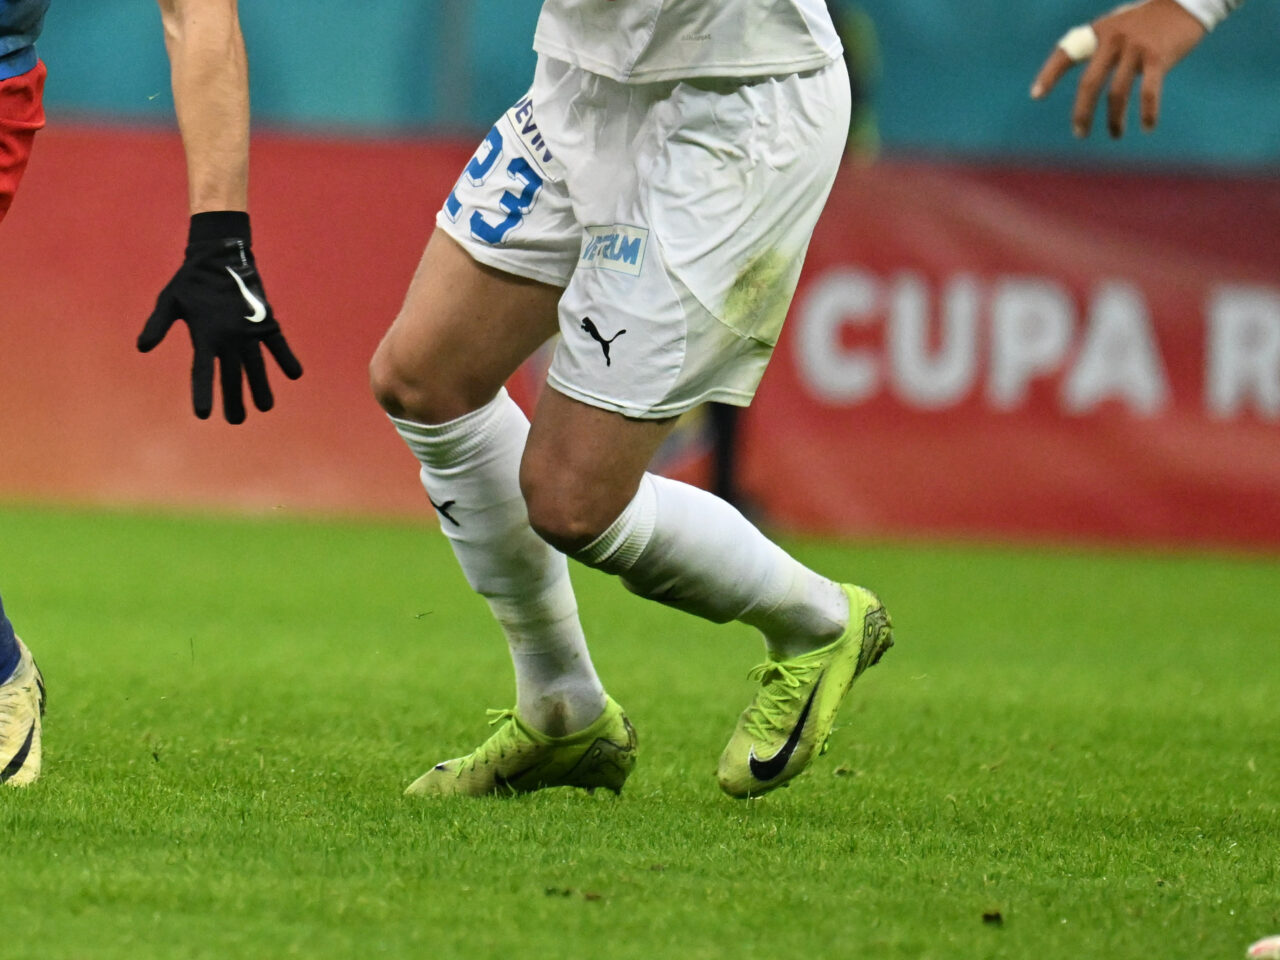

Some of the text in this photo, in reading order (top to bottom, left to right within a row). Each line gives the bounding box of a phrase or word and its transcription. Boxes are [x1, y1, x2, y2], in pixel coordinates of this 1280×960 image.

[443, 124, 544, 246] 23
[513, 95, 553, 163] EVIN
[796, 267, 1167, 415] CUPA
